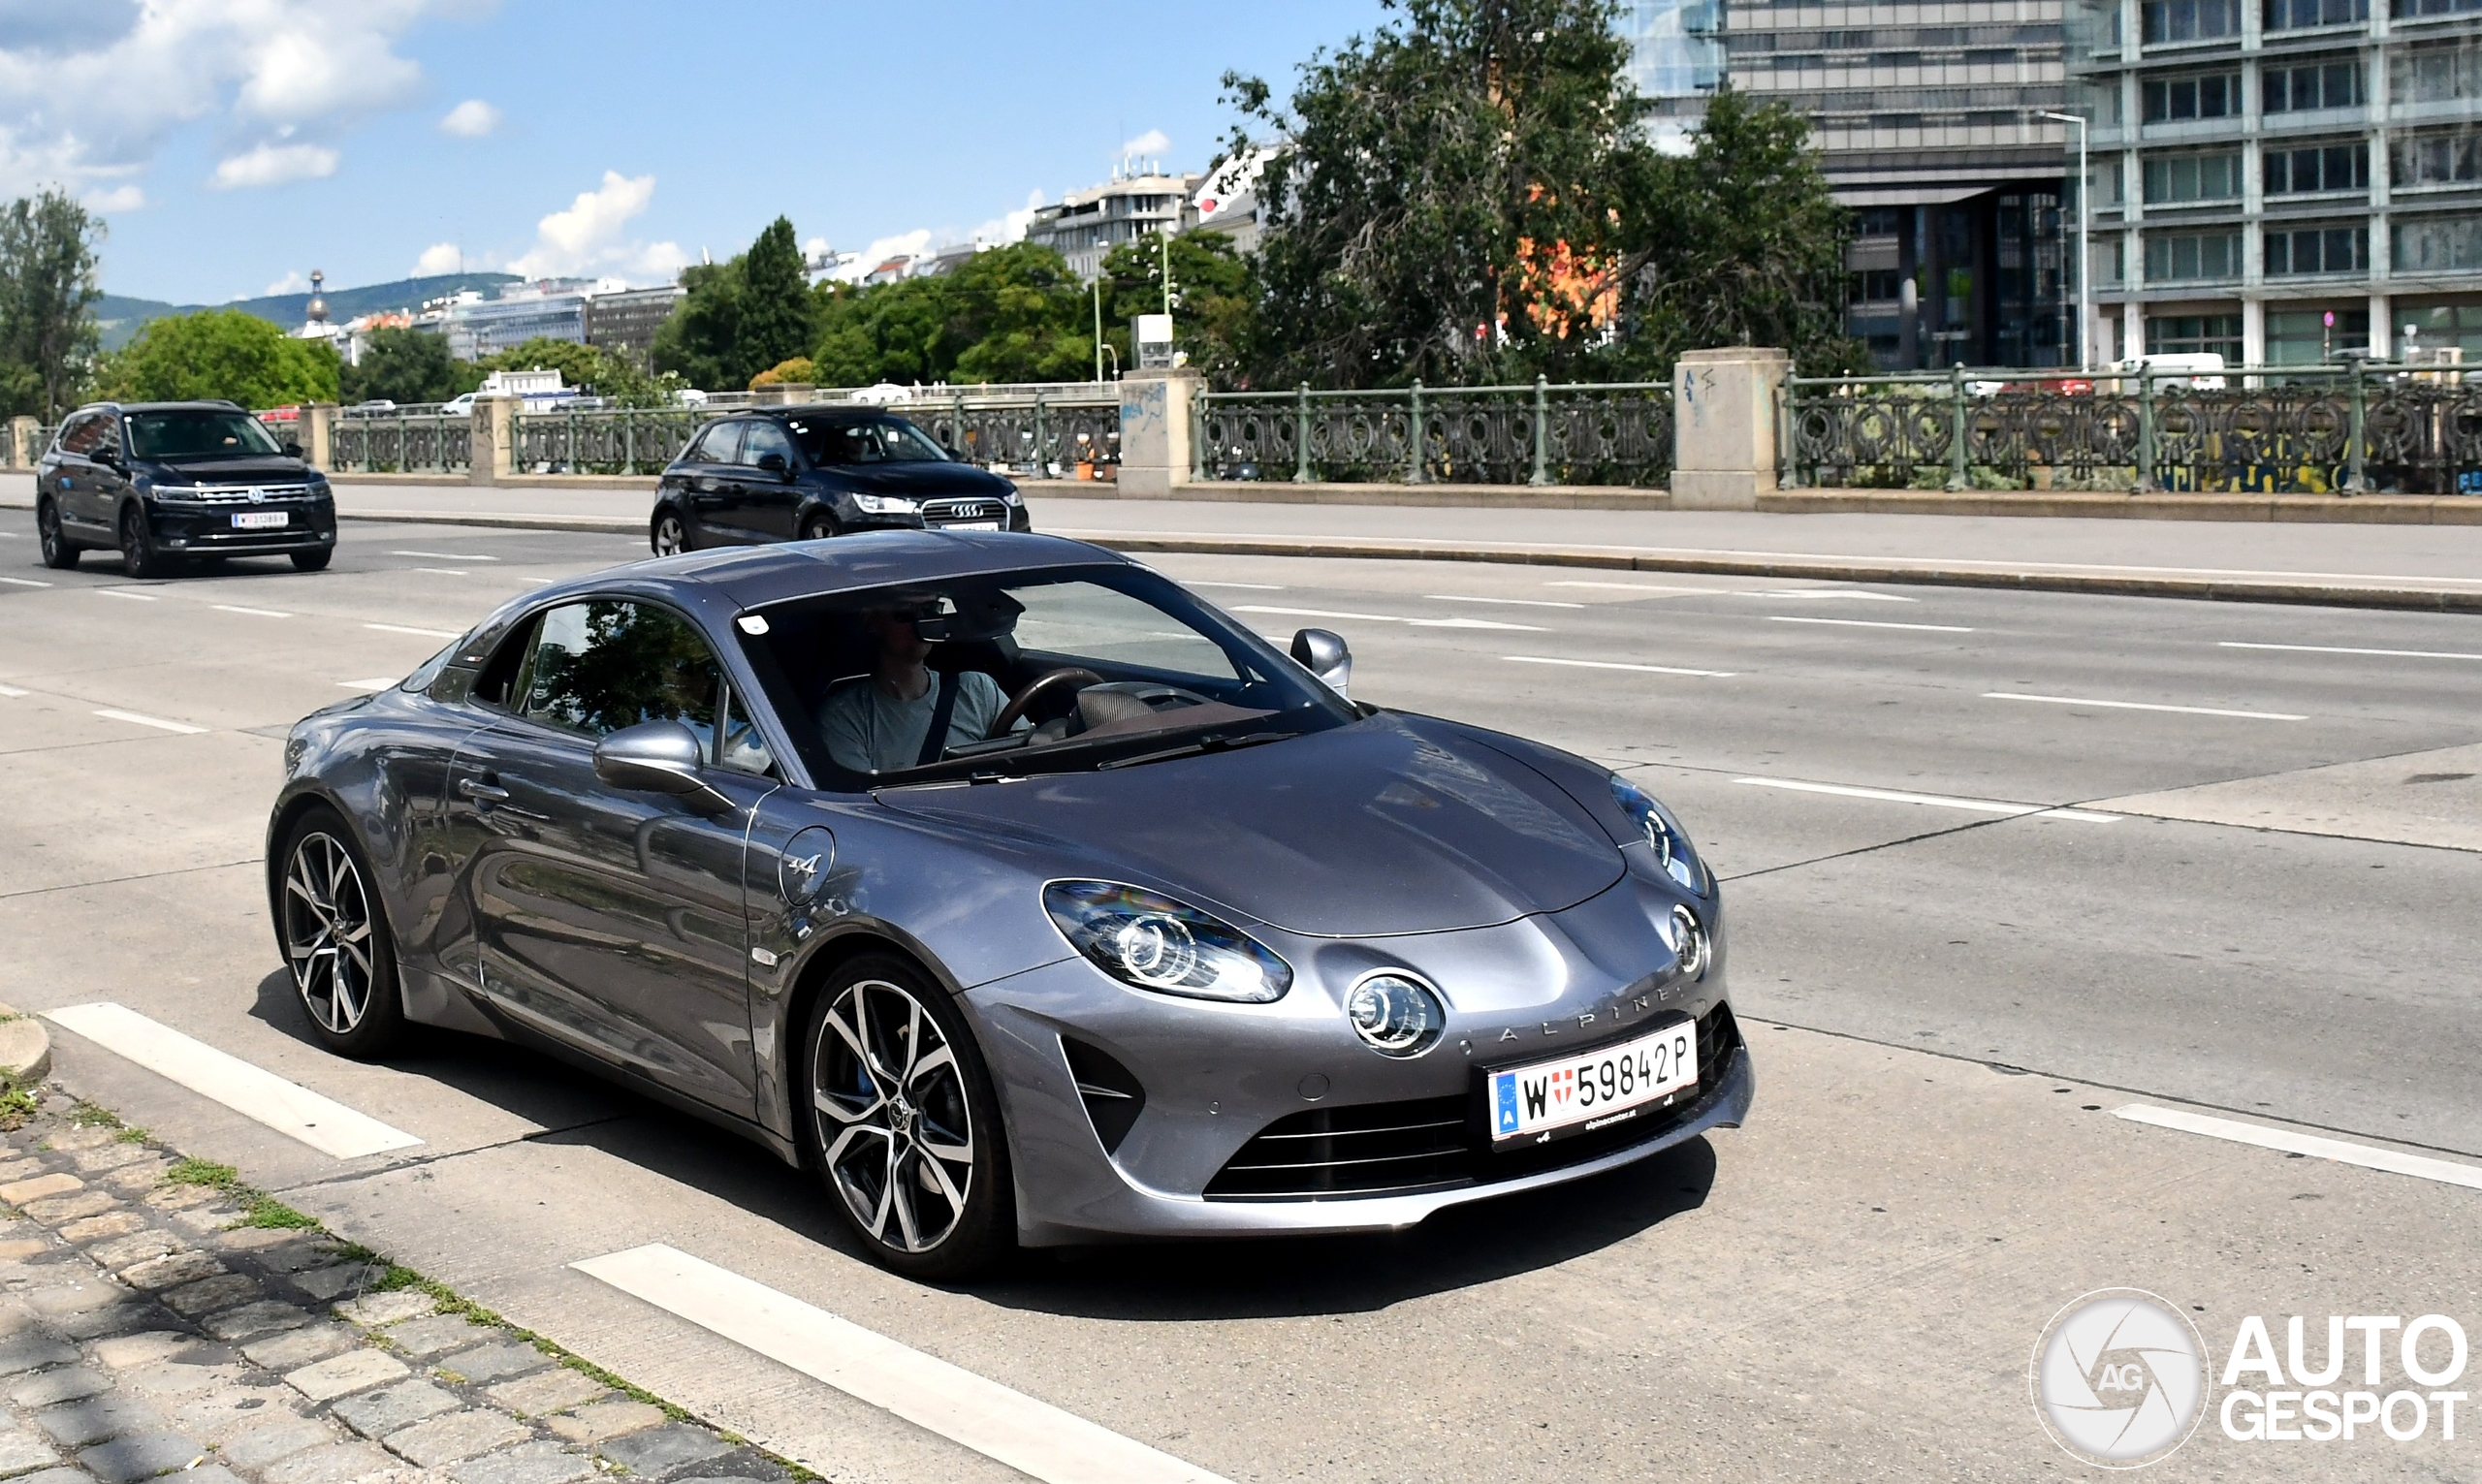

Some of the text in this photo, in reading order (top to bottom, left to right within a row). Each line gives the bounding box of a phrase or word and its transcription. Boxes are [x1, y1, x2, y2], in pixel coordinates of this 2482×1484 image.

[1499, 988, 1669, 1043] ALPINE
[1503, 1110, 1514, 1125] A
[1523, 1075, 1547, 1121] W
